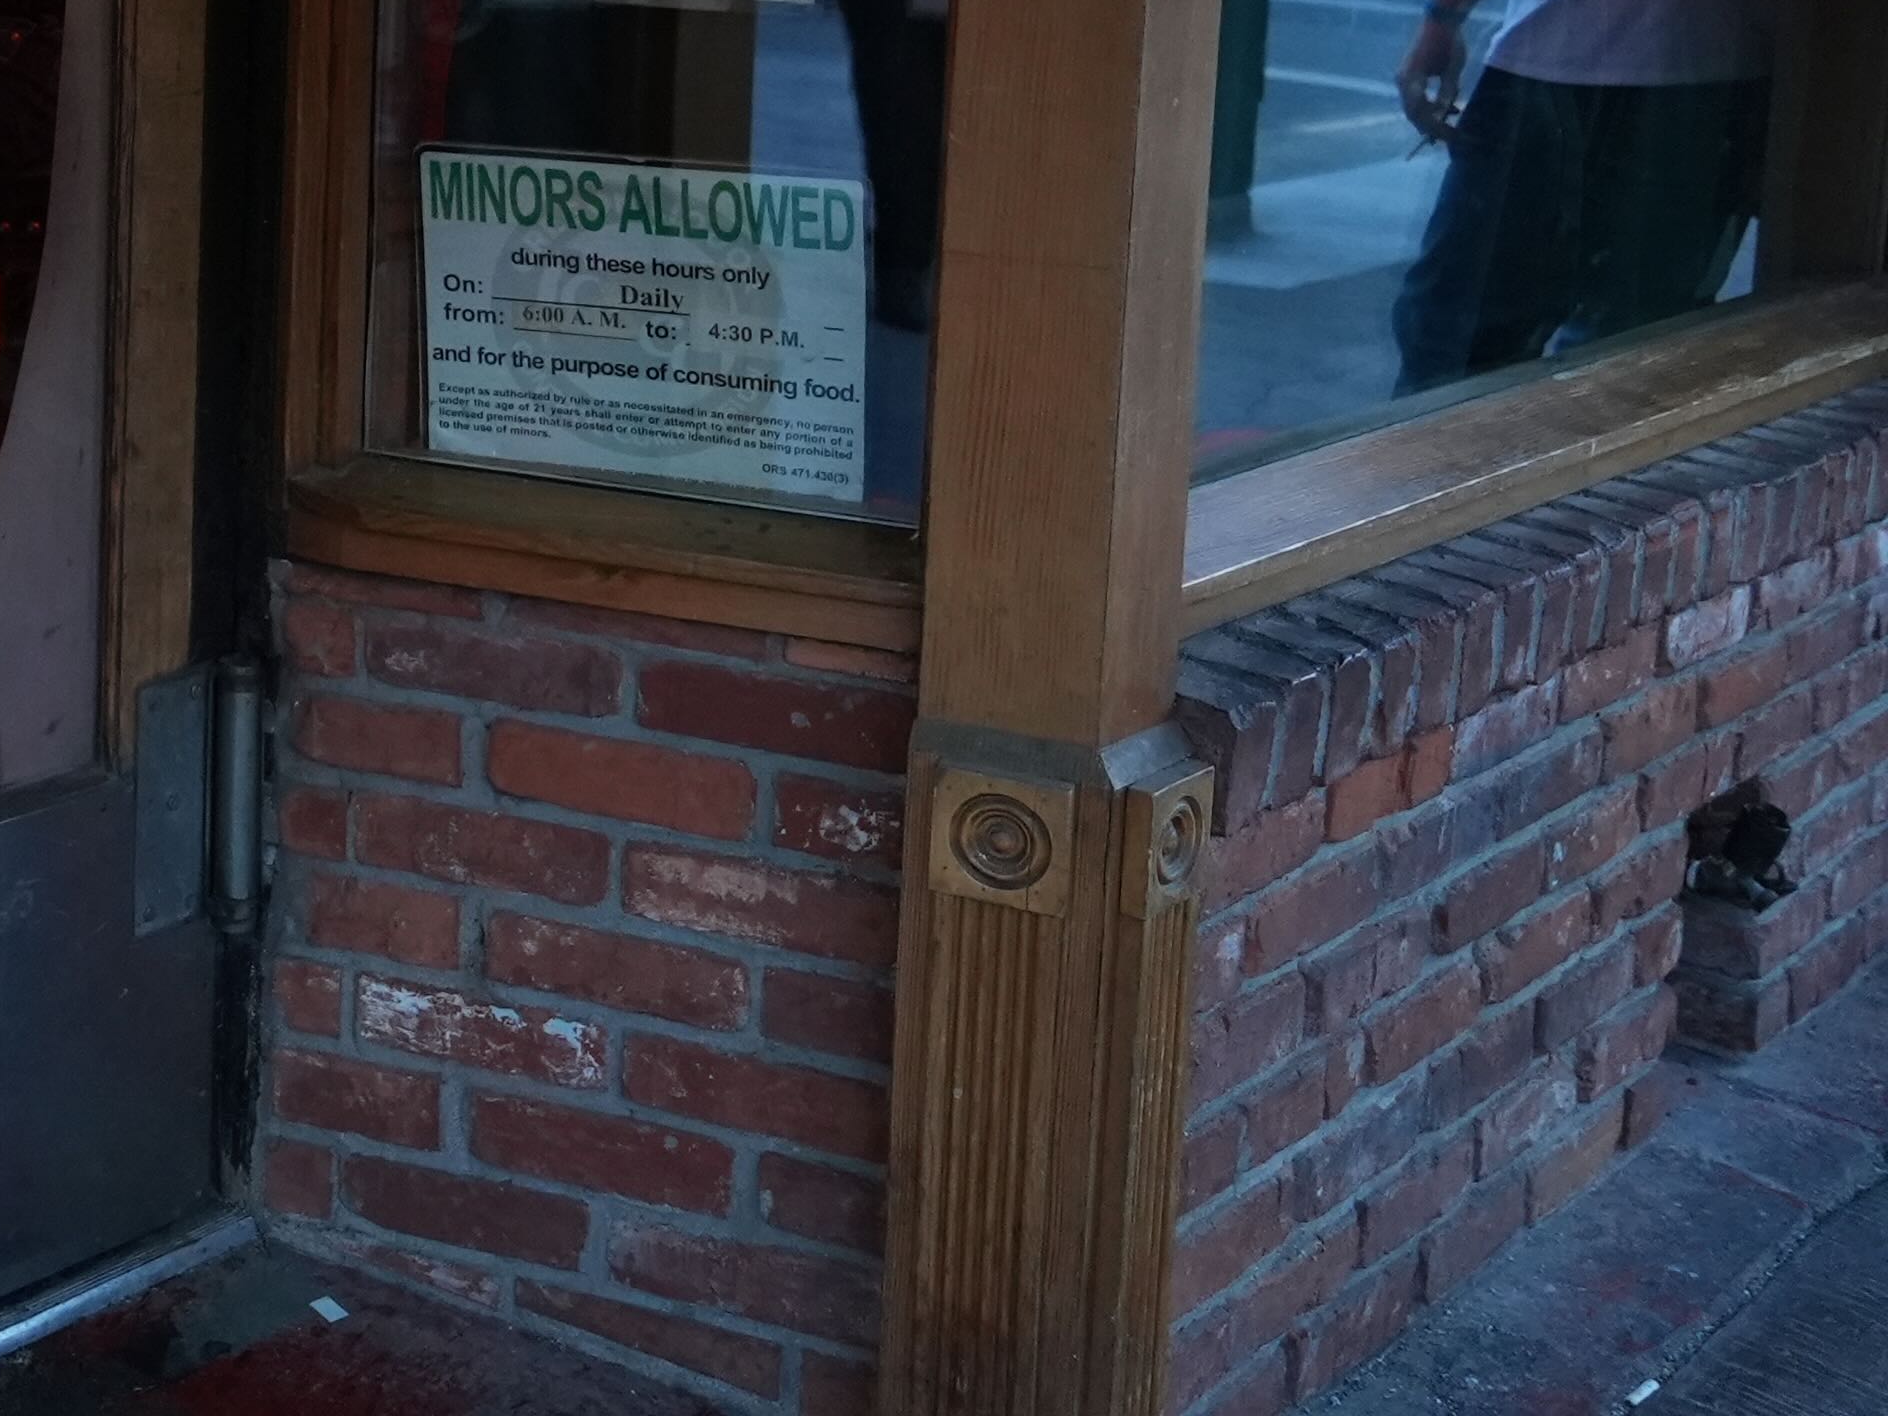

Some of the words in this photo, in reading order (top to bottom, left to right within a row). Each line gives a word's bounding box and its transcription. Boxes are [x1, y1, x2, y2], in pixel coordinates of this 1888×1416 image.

[428, 160, 607, 233] MINORS
[618, 173, 856, 252] ALLOWED
[443, 273, 484, 294] On:
[619, 284, 685, 313] Daily
[511, 247, 580, 274] during
[585, 252, 646, 275] these
[651, 257, 715, 281] hours
[721, 265, 771, 290] only
[443, 302, 505, 325] from:
[521, 304, 564, 323] 6:00
[645, 320, 677, 340] to:
[708, 322, 753, 343] 4:30
[759, 327, 805, 349] P.M.
[432, 345, 472, 363] and
[477, 346, 507, 366] for
[512, 349, 545, 369] the
[551, 356, 640, 379] purpose
[645, 363, 669, 382] of
[673, 368, 798, 400] consuming
[804, 378, 861, 404] food.
[438, 382, 476, 396] Except
[477, 387, 491, 396] as
[492, 389, 551, 402] authorized
[553, 392, 567, 405] by
[569, 395, 591, 405] rule
[593, 397, 606, 407] or
[607, 399, 621, 409] as
[623, 400, 695, 416] necessitated
[697, 407, 708, 418] in
[710, 410, 725, 420] an
[796, 419, 811, 430] no
[813, 423, 855, 436] person
[438, 395, 470, 406] under
[473, 397, 491, 409] the
[495, 402, 515, 412] age
[518, 402, 530, 413] of
[533, 403, 546, 413] 21
[550, 406, 581, 417] years
[584, 408, 612, 420] shall
[615, 413, 644, 424] enter
[647, 416, 660, 426] or
[663, 417, 708, 432] attempt
[711, 422, 722, 433] to
[726, 424, 756, 436] enter
[759, 428, 781, 441] any
[785, 431, 827, 445] portion
[830, 436, 843, 447] of
[438, 419, 450, 430] to
[452, 420, 470, 431] the
[473, 423, 493, 433] use
[495, 424, 507, 434] of
[509, 425, 552, 439] minors.
[438, 406, 484, 420] licensed
[486, 412, 537, 425] premises
[539, 416, 561, 428] that
[562, 419, 573, 429] is
[574, 420, 613, 433] posted
[615, 425, 628, 435] or
[630, 425, 686, 441] otherwise
[743, 439, 757, 450] as
[759, 439, 792, 455] being
[793, 444, 853, 460] prohibited
[761, 463, 787, 477] ORS
